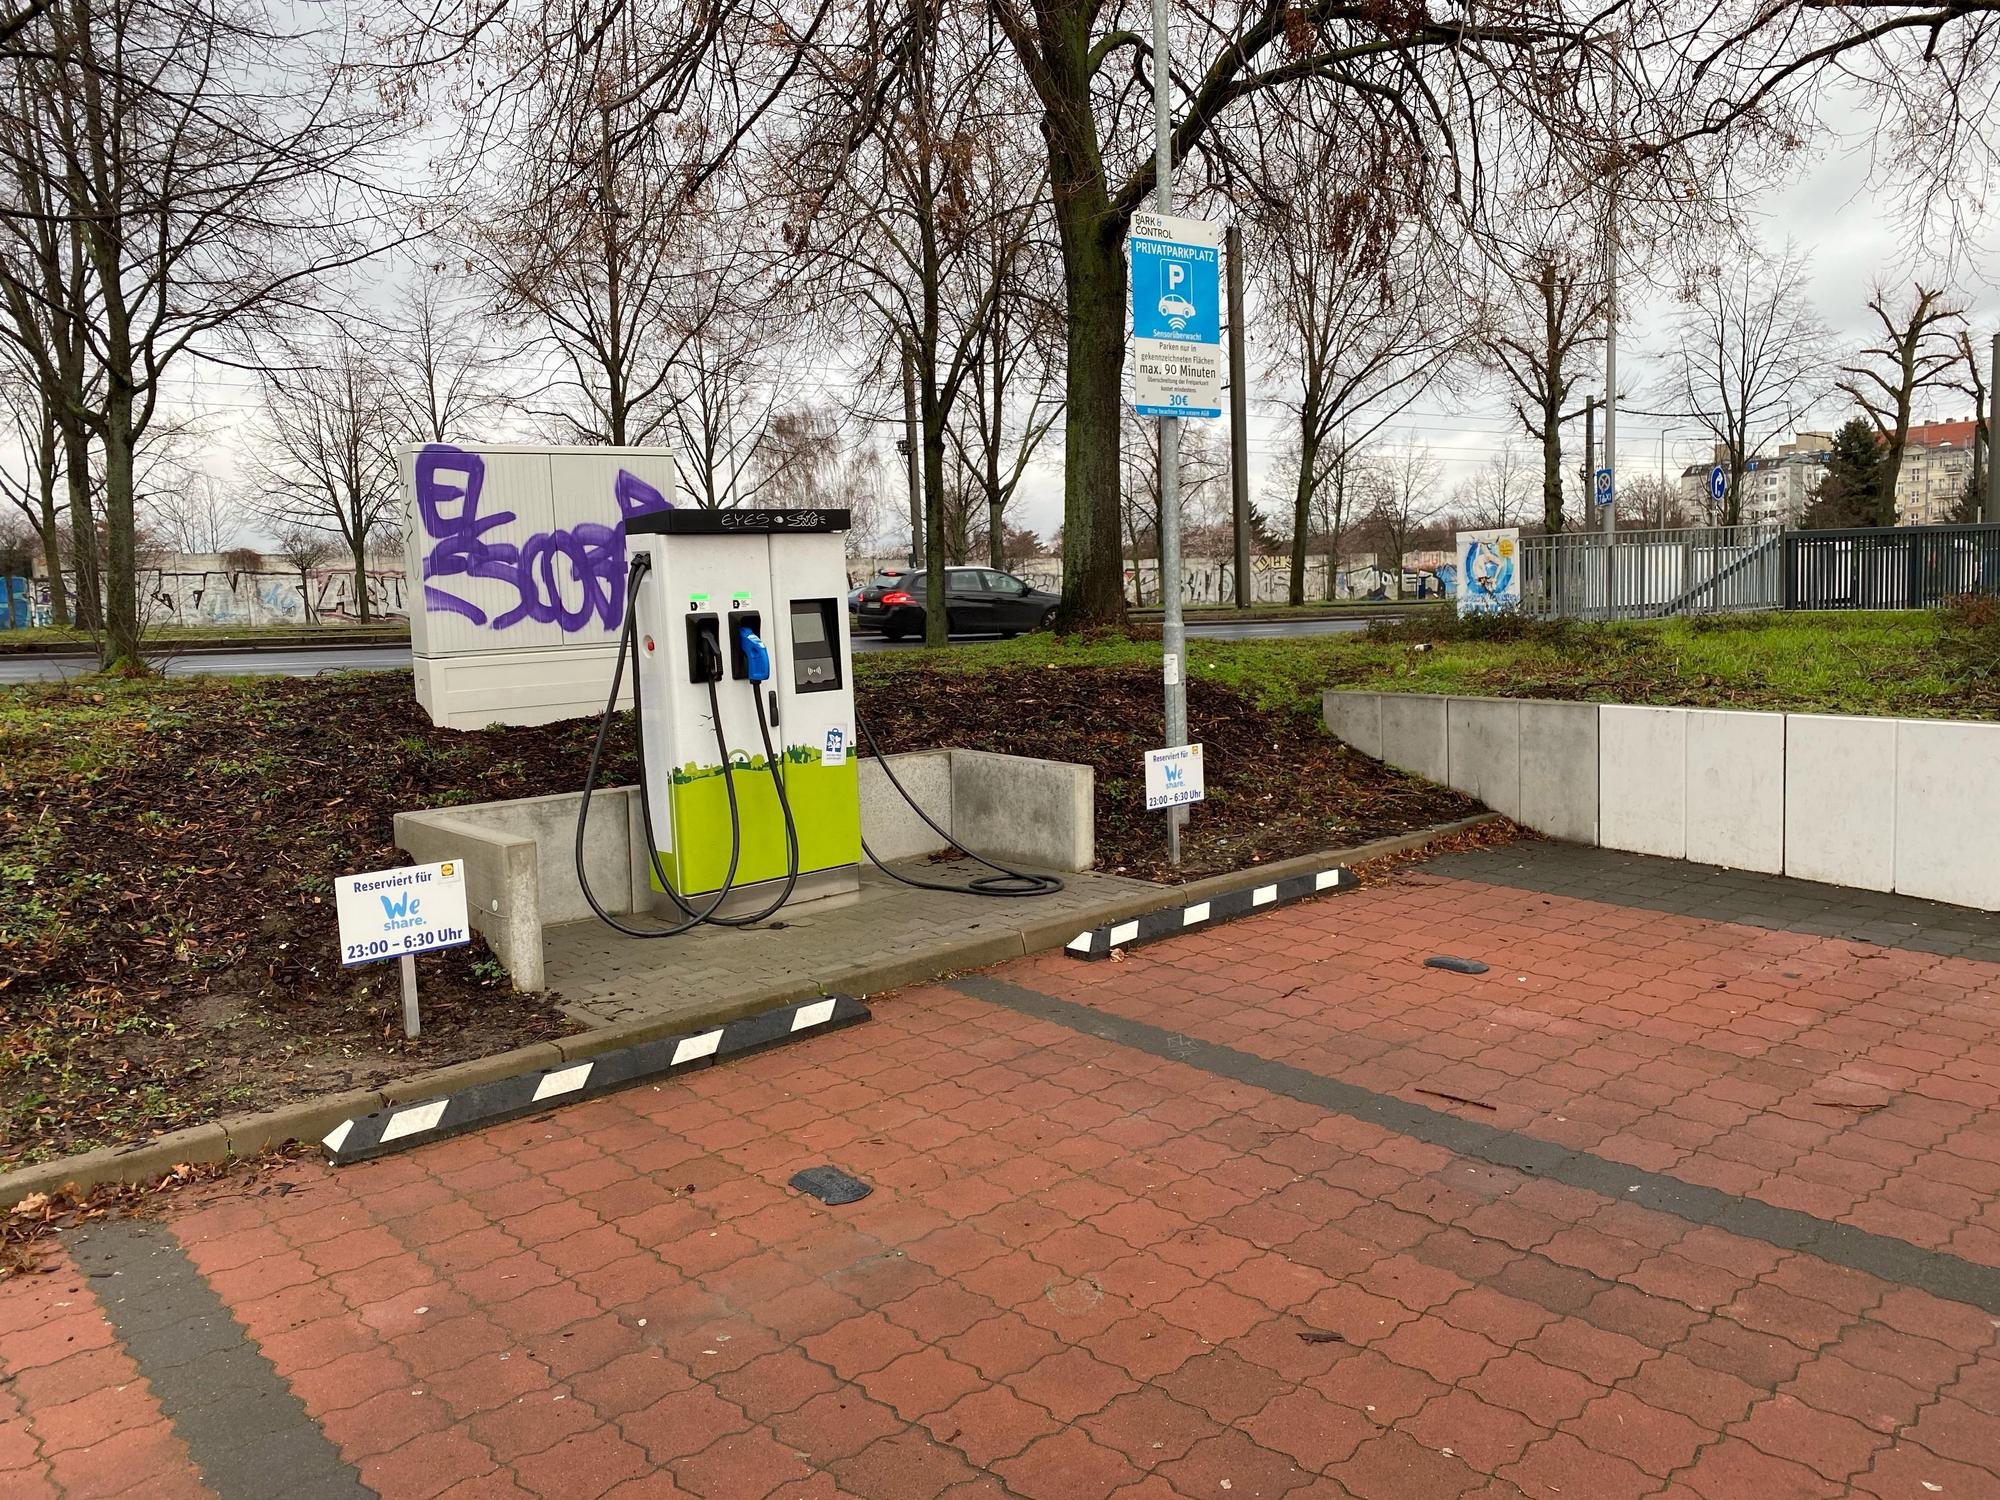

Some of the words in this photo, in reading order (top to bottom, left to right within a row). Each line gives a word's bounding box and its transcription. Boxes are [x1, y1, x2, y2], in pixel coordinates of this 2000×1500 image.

[1135, 214, 1156, 227] PARK
[1156, 218, 1162, 227] &
[1135, 225, 1173, 239] CONTROL
[1135, 241, 1214, 262] PRIVATPARKPLATZ
[1168, 264, 1184, 290] P
[1153, 328, 1202, 341] Sensorüberwacht
[1159, 341, 1179, 351] Parken
[1141, 352, 1192, 363] gekennzeichneten
[1193, 356, 1214, 365] Flächen
[1140, 364, 1162, 375] max.
[1164, 363, 1177, 375] 90
[1180, 365, 1216, 378] Minuten
[1169, 394, 1188, 406] 30€
[1598, 493, 1612, 505] TAXI
[721, 513, 770, 526] EYES
[1152, 752, 1180, 763] Reserviert
[1164, 763, 1183, 782] We
[1149, 795, 1168, 807] 23:00
[1174, 791, 1188, 802] 6:30
[1189, 789, 1201, 799] Uhr
[353, 875, 413, 893] Reserviert
[415, 872, 432, 884] für
[380, 891, 421, 919] We
[383, 916, 427, 932] share.
[347, 940, 388, 960] 23:00
[403, 931, 434, 949] 6:30
[438, 927, 463, 943] Uhr
